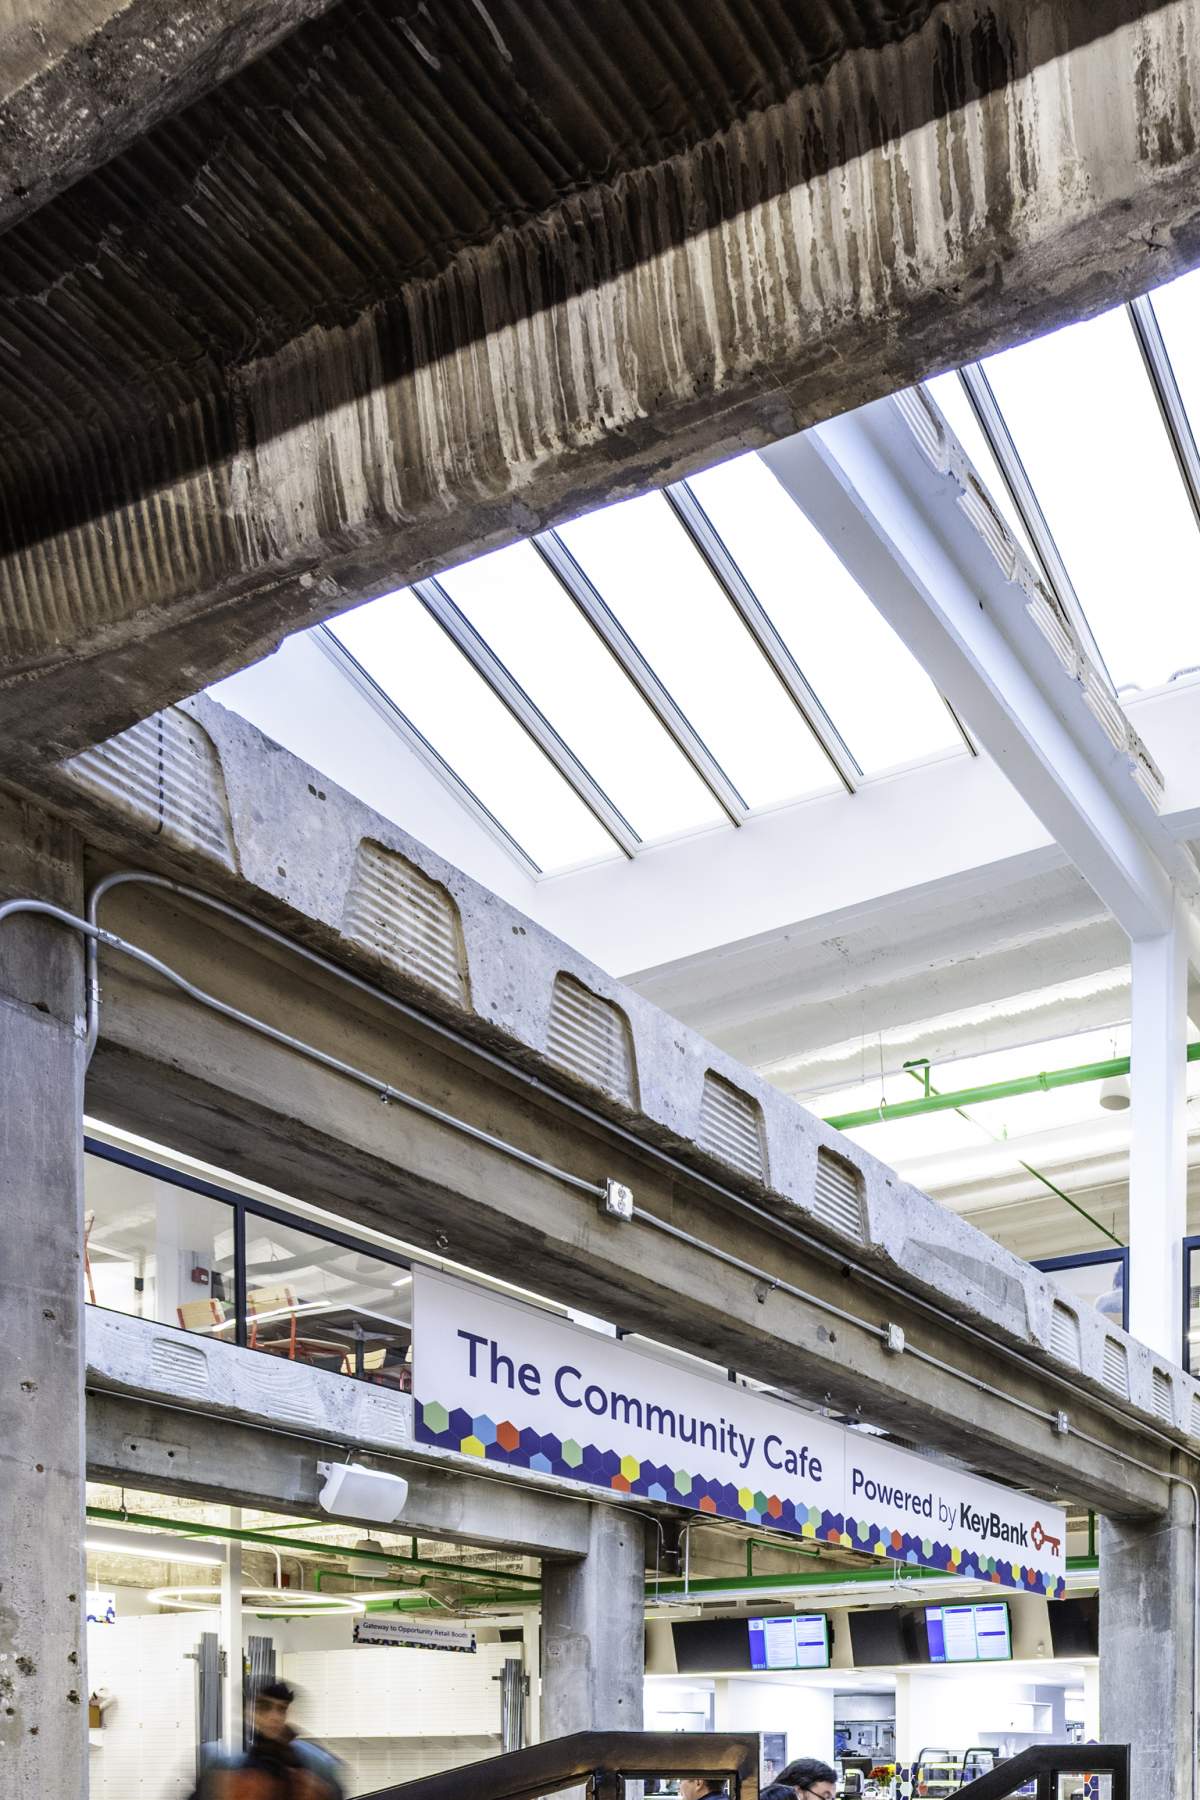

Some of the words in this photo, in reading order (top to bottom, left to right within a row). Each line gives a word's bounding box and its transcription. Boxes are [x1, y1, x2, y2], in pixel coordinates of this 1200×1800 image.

[458, 1329, 540, 1395] The
[554, 1366, 755, 1468] Community
[764, 1435, 822, 1481] Cafe
[852, 1468, 932, 1518] Powered
[939, 1497, 957, 1531] by
[960, 1503, 1028, 1547] KeyBank
[363, 1622, 389, 1632] Gateway
[398, 1626, 433, 1636] Opportunity
[434, 1629, 450, 1637] Retail
